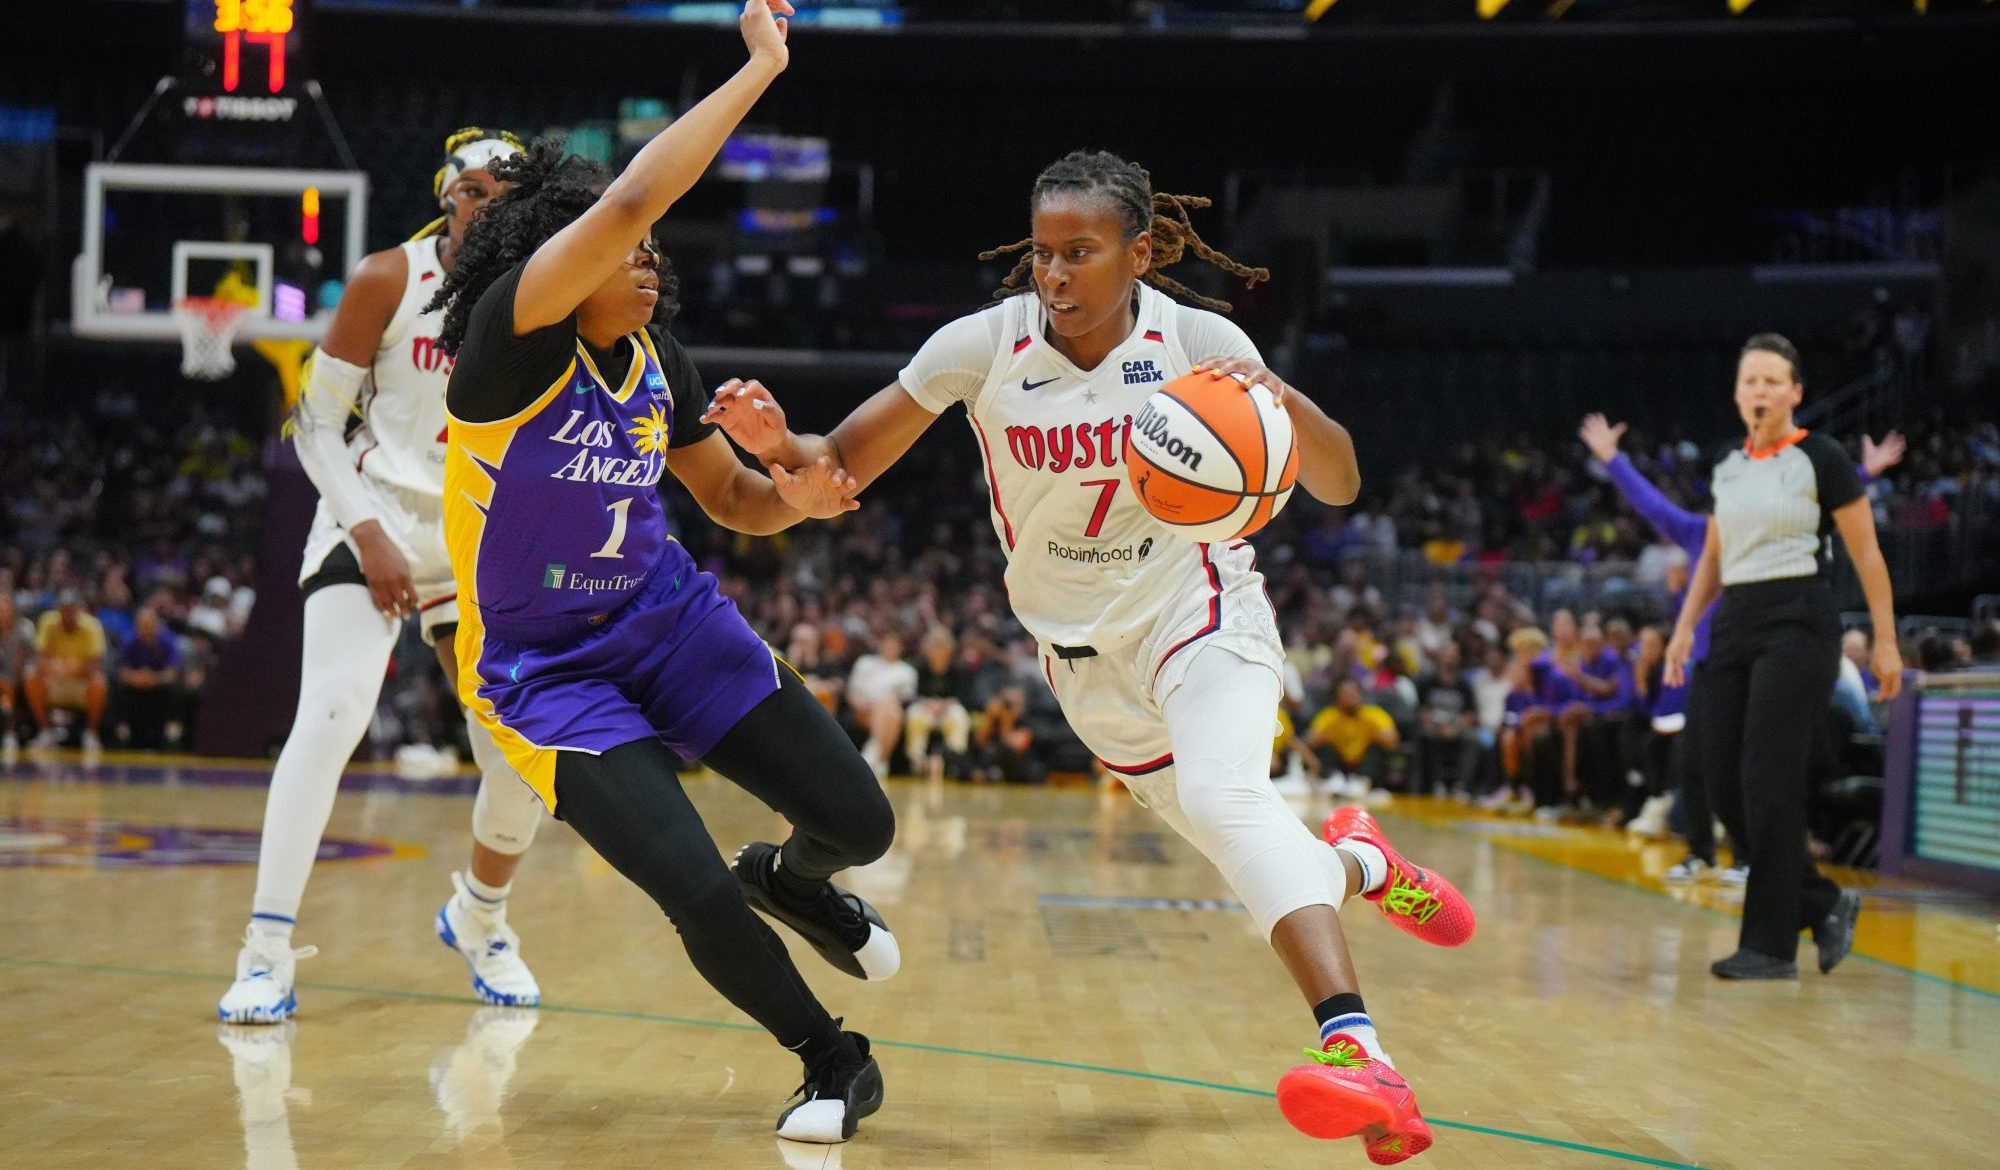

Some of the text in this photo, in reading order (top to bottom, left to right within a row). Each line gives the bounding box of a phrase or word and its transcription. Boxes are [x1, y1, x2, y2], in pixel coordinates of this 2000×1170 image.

[1122, 360, 1155, 372] CAR
[1123, 370, 1164, 385] max
[549, 409, 616, 448] LOS
[1004, 414, 1133, 474] mysti
[1134, 399, 1203, 473] Wilson
[590, 497, 634, 559] 1
[1080, 479, 1120, 538] 7
[1048, 541, 1133, 564] Robinhood
